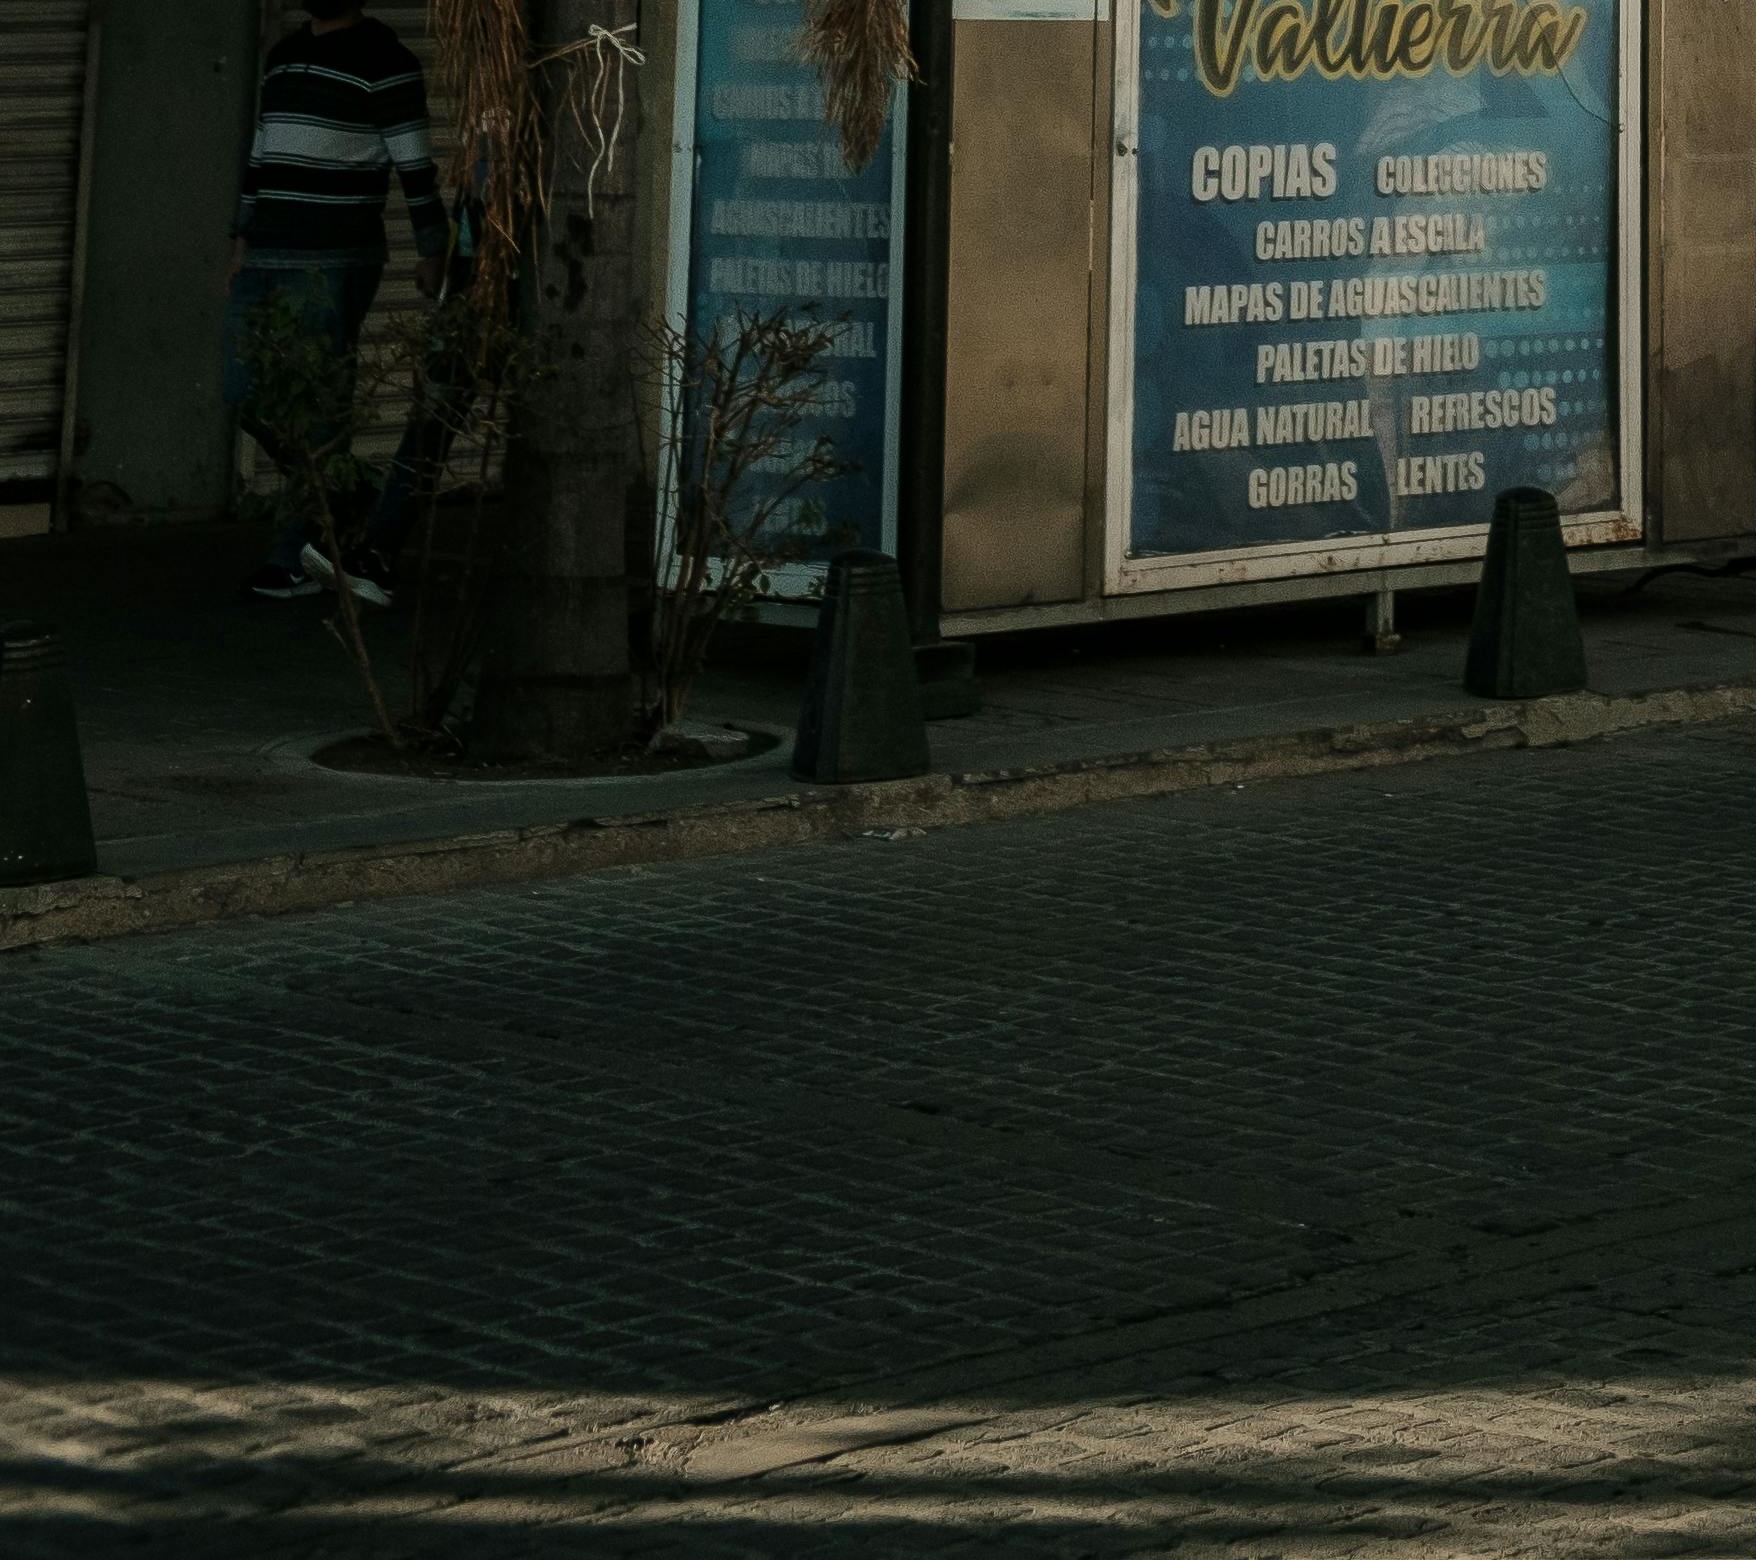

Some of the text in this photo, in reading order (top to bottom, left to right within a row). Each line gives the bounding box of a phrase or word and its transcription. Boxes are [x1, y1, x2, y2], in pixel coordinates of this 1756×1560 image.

[1191, 142, 1549, 202] COPIAS COLECCIONES
[1255, 213, 1487, 261] CARROS A ESCALA
[1184, 270, 1547, 326] MAPAS DE AGUASCALIENTES
[1256, 331, 1481, 384] PALETAS DE HIELO
[1172, 386, 1558, 452] AGUA NATURAL REFRESCOS
[1247, 451, 1487, 509] GORRAS LENTES
